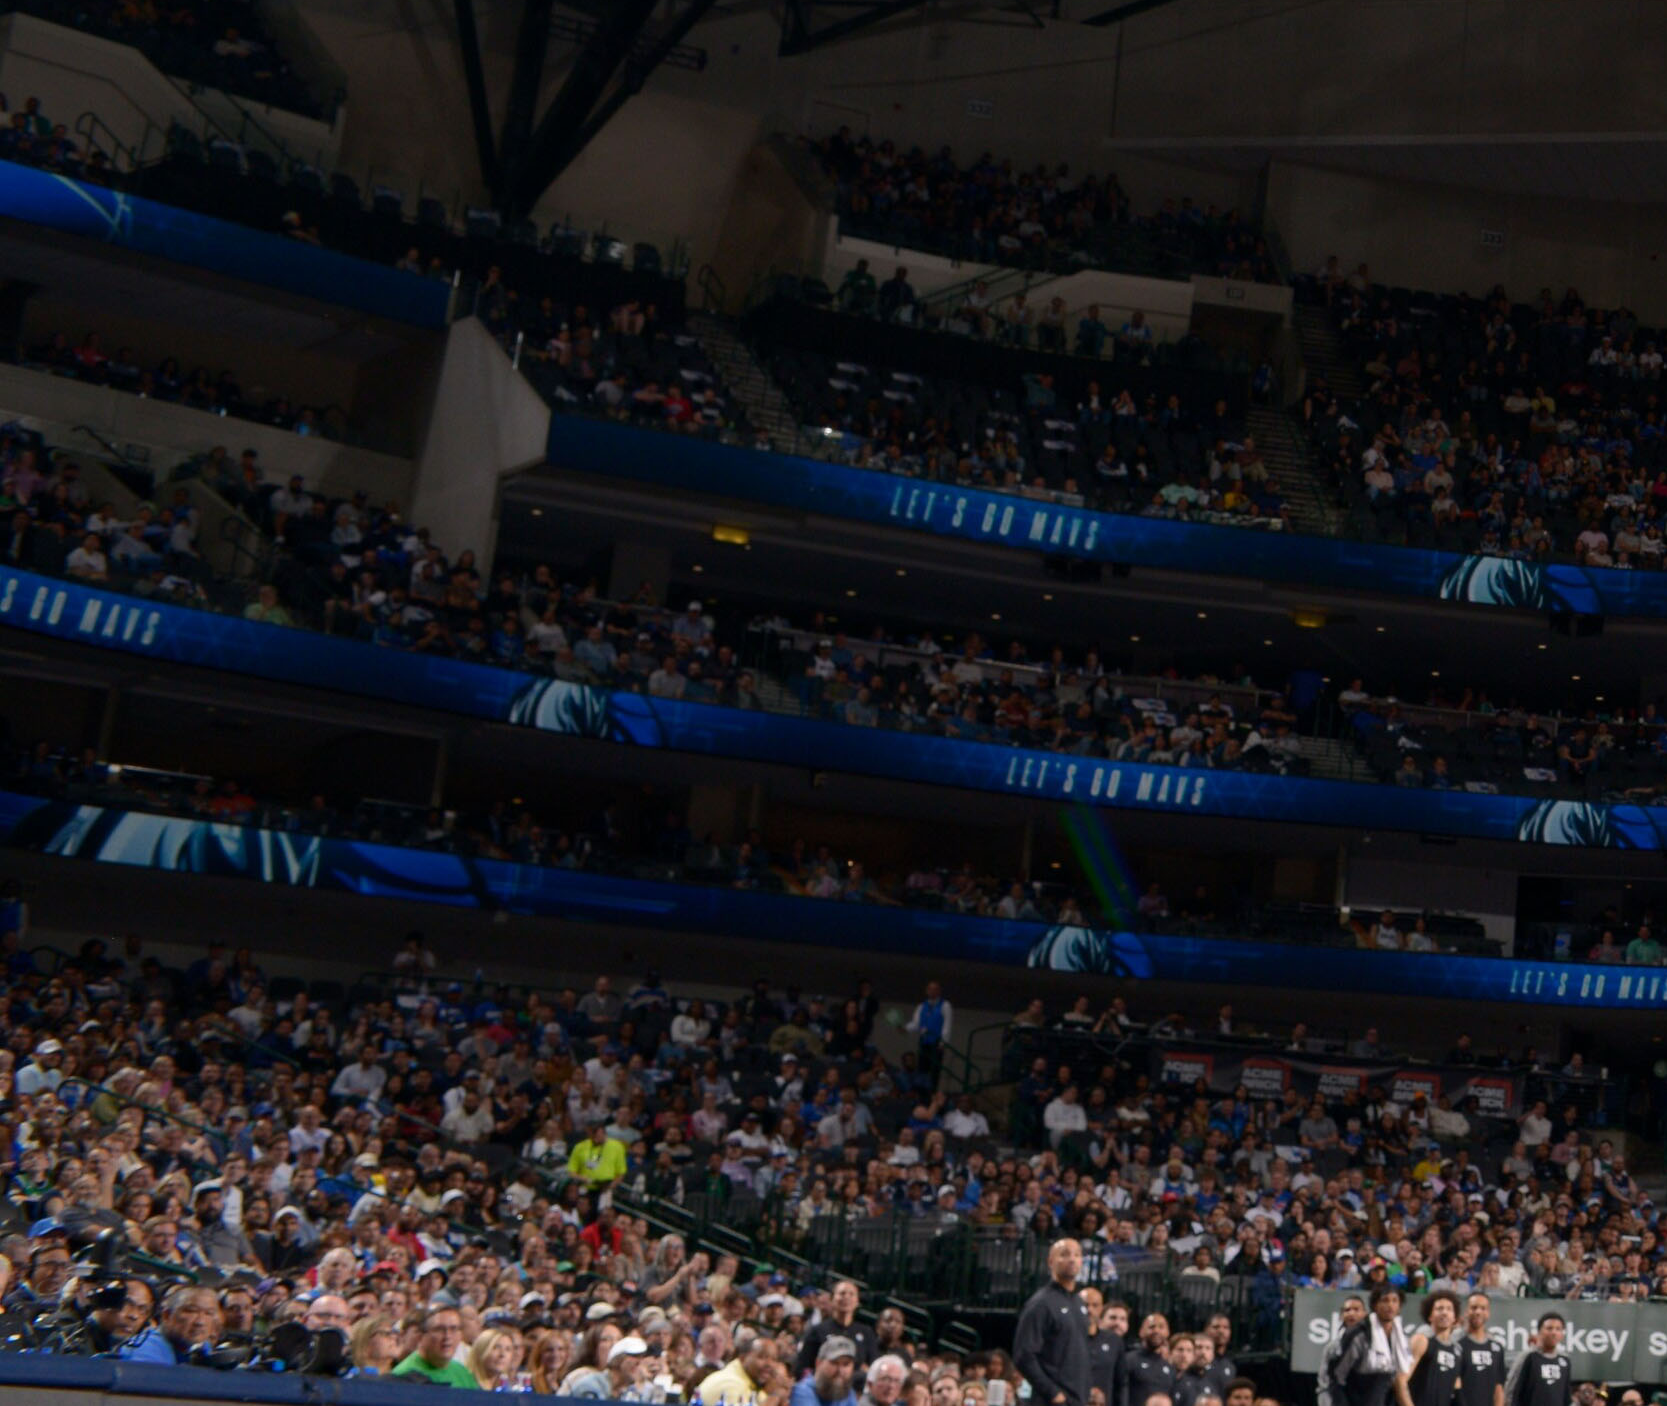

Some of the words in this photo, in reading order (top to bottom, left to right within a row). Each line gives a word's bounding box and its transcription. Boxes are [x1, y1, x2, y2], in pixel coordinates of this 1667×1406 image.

[891, 486, 966, 528] LET'S
[981, 502, 1014, 535] GO
[1029, 512, 1098, 550] MAVS
[1494, 1319, 1630, 1361] shikey
